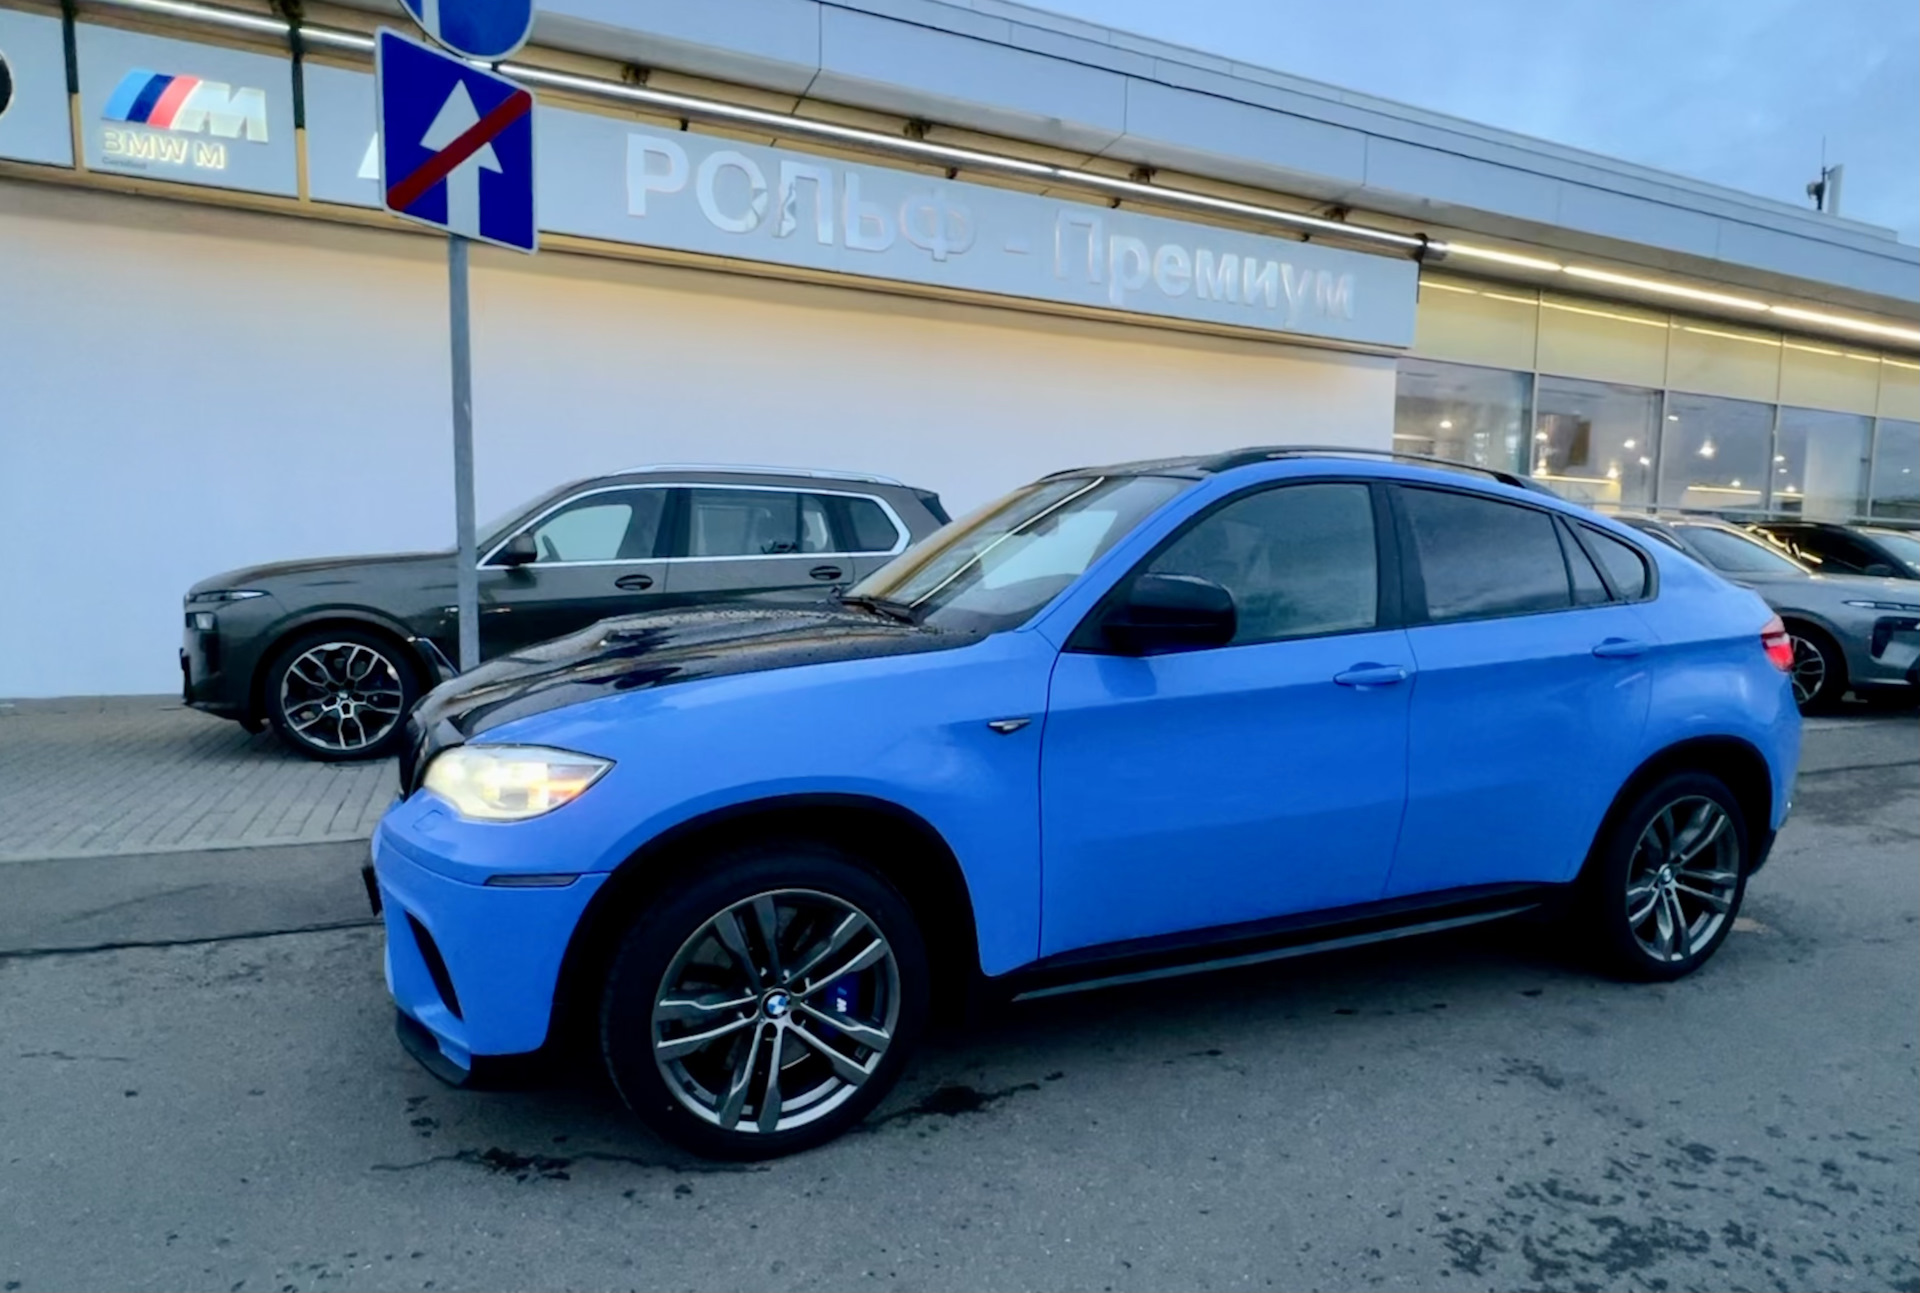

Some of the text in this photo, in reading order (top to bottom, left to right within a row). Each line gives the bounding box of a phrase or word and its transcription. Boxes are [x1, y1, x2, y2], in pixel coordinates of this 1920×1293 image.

[168, 80, 268, 142] M
[103, 128, 188, 164] BMW
[194, 140, 226, 169] M
[626, 133, 974, 262] РОЛЬФ
[1054, 208, 1357, 329] Премиум
